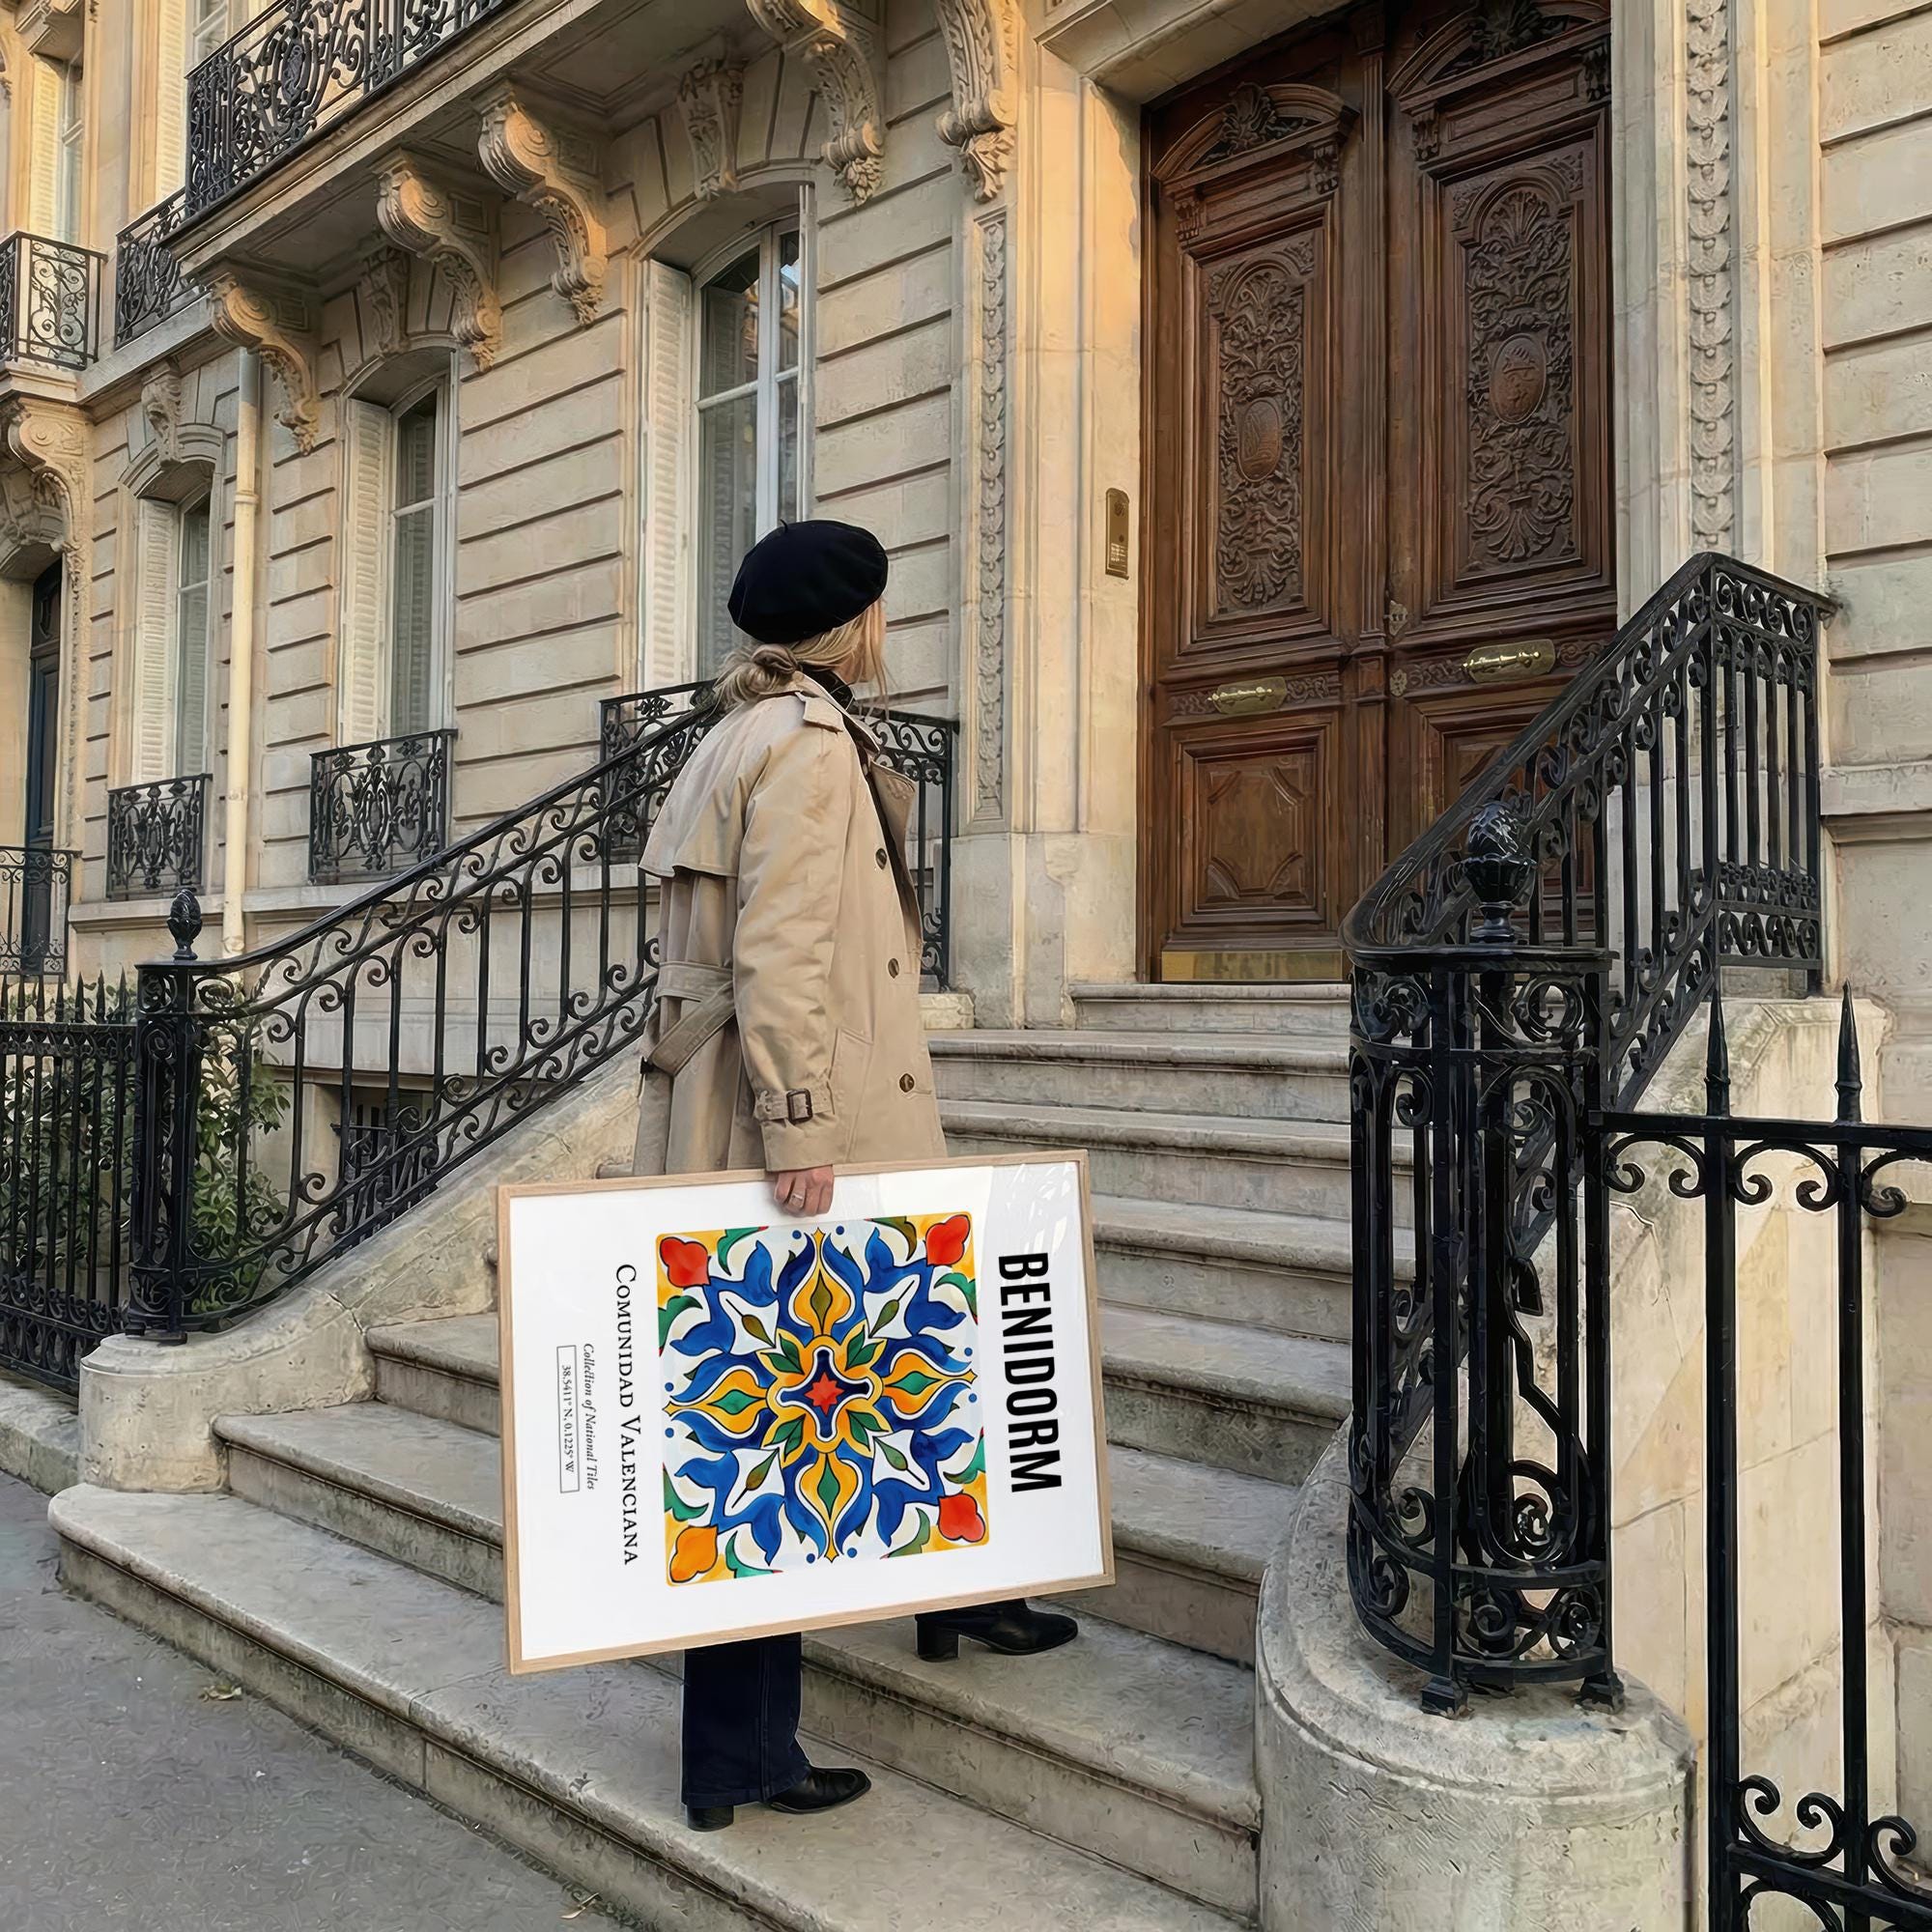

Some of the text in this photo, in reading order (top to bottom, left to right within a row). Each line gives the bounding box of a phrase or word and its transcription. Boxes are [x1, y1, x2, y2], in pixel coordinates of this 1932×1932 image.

[565, 1460, 575, 1473] W
[581, 1343, 599, 1490] Collection of National Tiles
[615, 1264, 641, 1566] COMUNIDAD VALENCIANA
[998, 1252, 1063, 1493] BENIDORM
